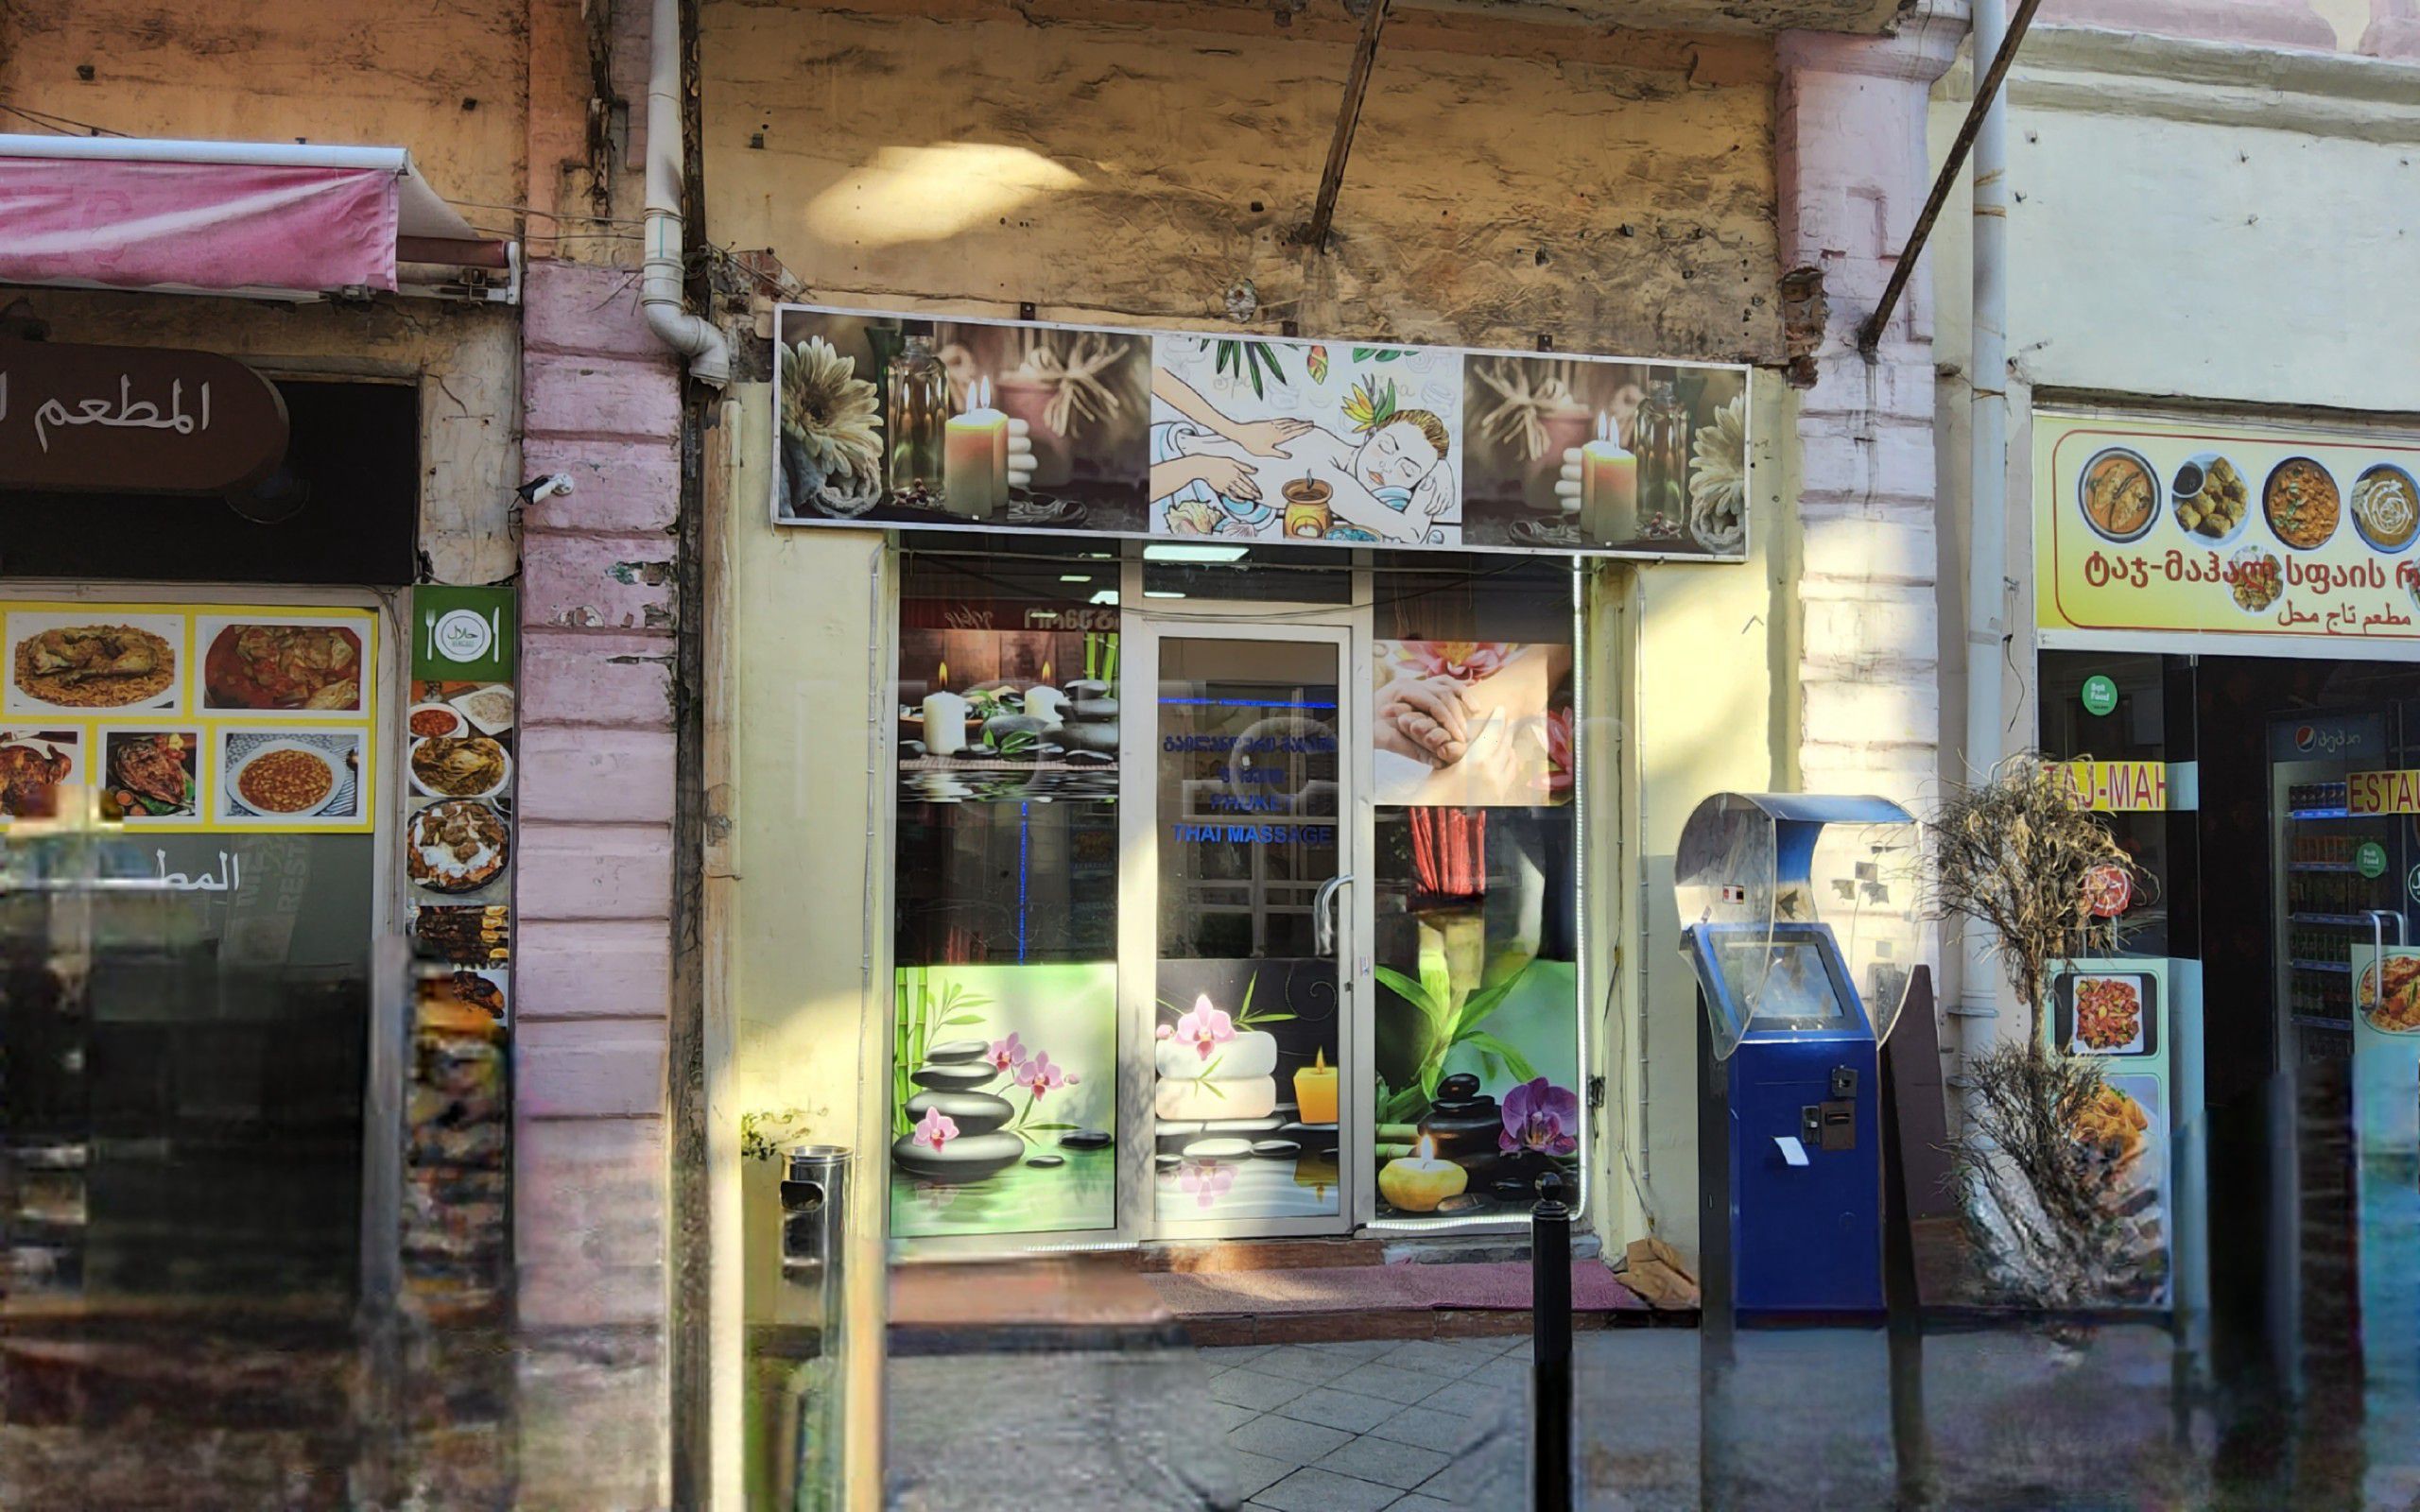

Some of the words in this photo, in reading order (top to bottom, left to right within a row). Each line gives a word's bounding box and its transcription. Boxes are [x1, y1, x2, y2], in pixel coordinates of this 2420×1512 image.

[34, 374, 212, 454] المطعم
[2083, 550, 2275, 593] ტაჯ-მაჰალ
[2286, 554, 2386, 594] სფაის
[2277, 600, 2319, 626] محل
[2325, 603, 2357, 634] تاج
[2362, 603, 2411, 635] مطعم
[447, 625, 478, 640] حلال
[1210, 793, 1298, 811] PHUKET
[1173, 825, 1221, 842] THAI
[1227, 825, 1333, 844] MASSAGE
